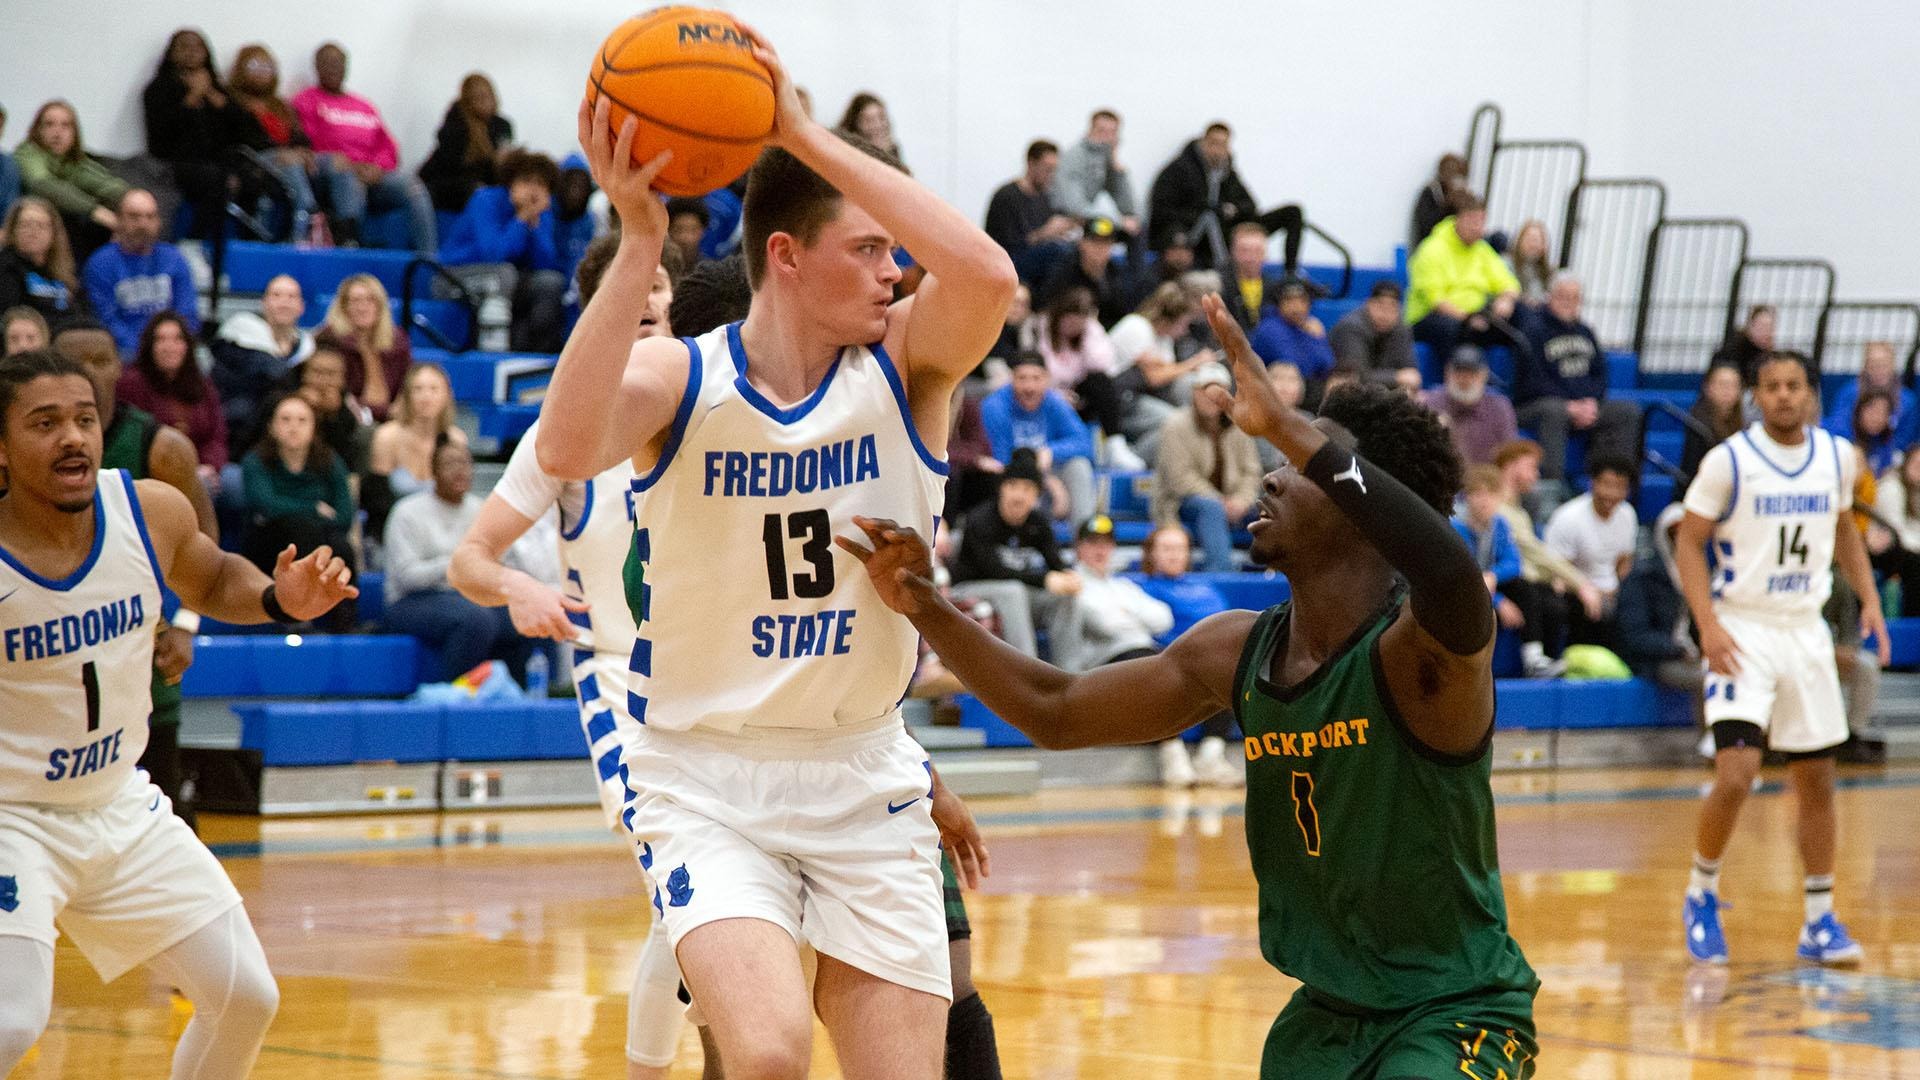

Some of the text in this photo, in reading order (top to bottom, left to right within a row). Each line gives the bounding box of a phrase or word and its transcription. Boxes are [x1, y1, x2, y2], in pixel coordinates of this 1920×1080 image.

[703, 433, 880, 497] FREDONIA
[762, 508, 835, 600] 13
[1778, 523, 1808, 567] 14
[4, 594, 144, 663] FREDONIA
[752, 609, 857, 659] STATE
[82, 660, 101, 733] 1
[45, 727, 124, 782] STATE
[1244, 717, 1370, 762] OCKPORT
[1291, 770, 1321, 857] 1
